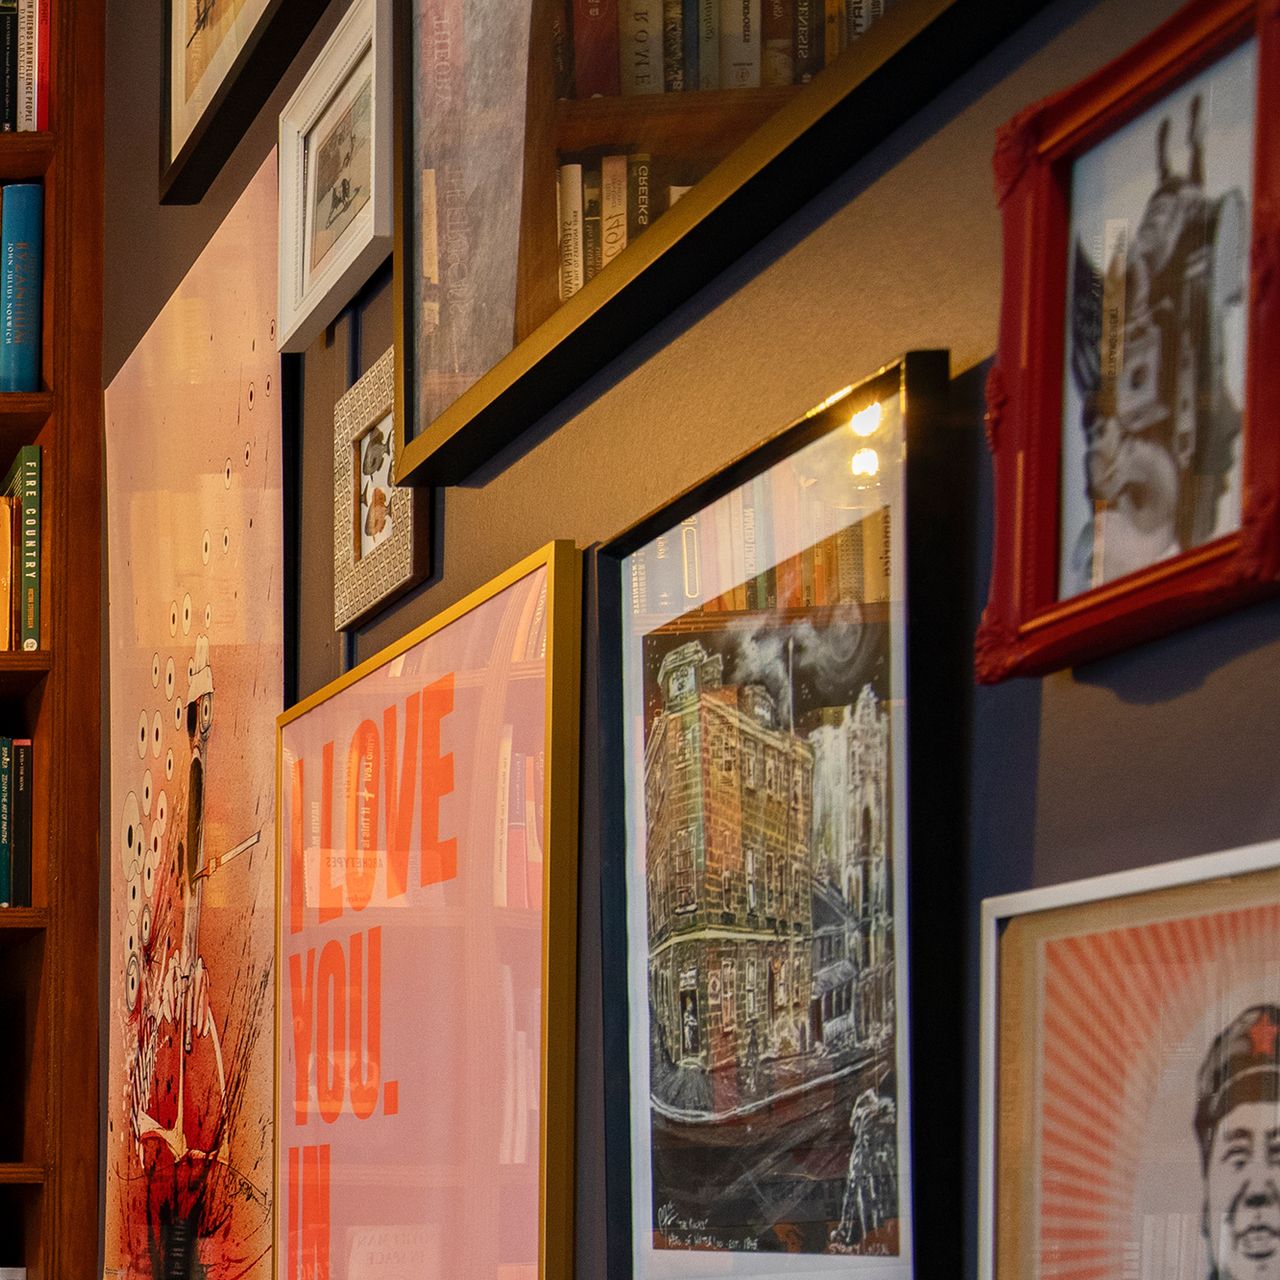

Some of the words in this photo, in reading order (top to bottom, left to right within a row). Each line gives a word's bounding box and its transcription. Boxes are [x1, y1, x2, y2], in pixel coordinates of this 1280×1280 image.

[25, 462, 36, 497] FIRE
[25, 508, 37, 579] COUNTRY
[316, 672, 458, 925] LOVE
[288, 926, 400, 1127] YOU.
